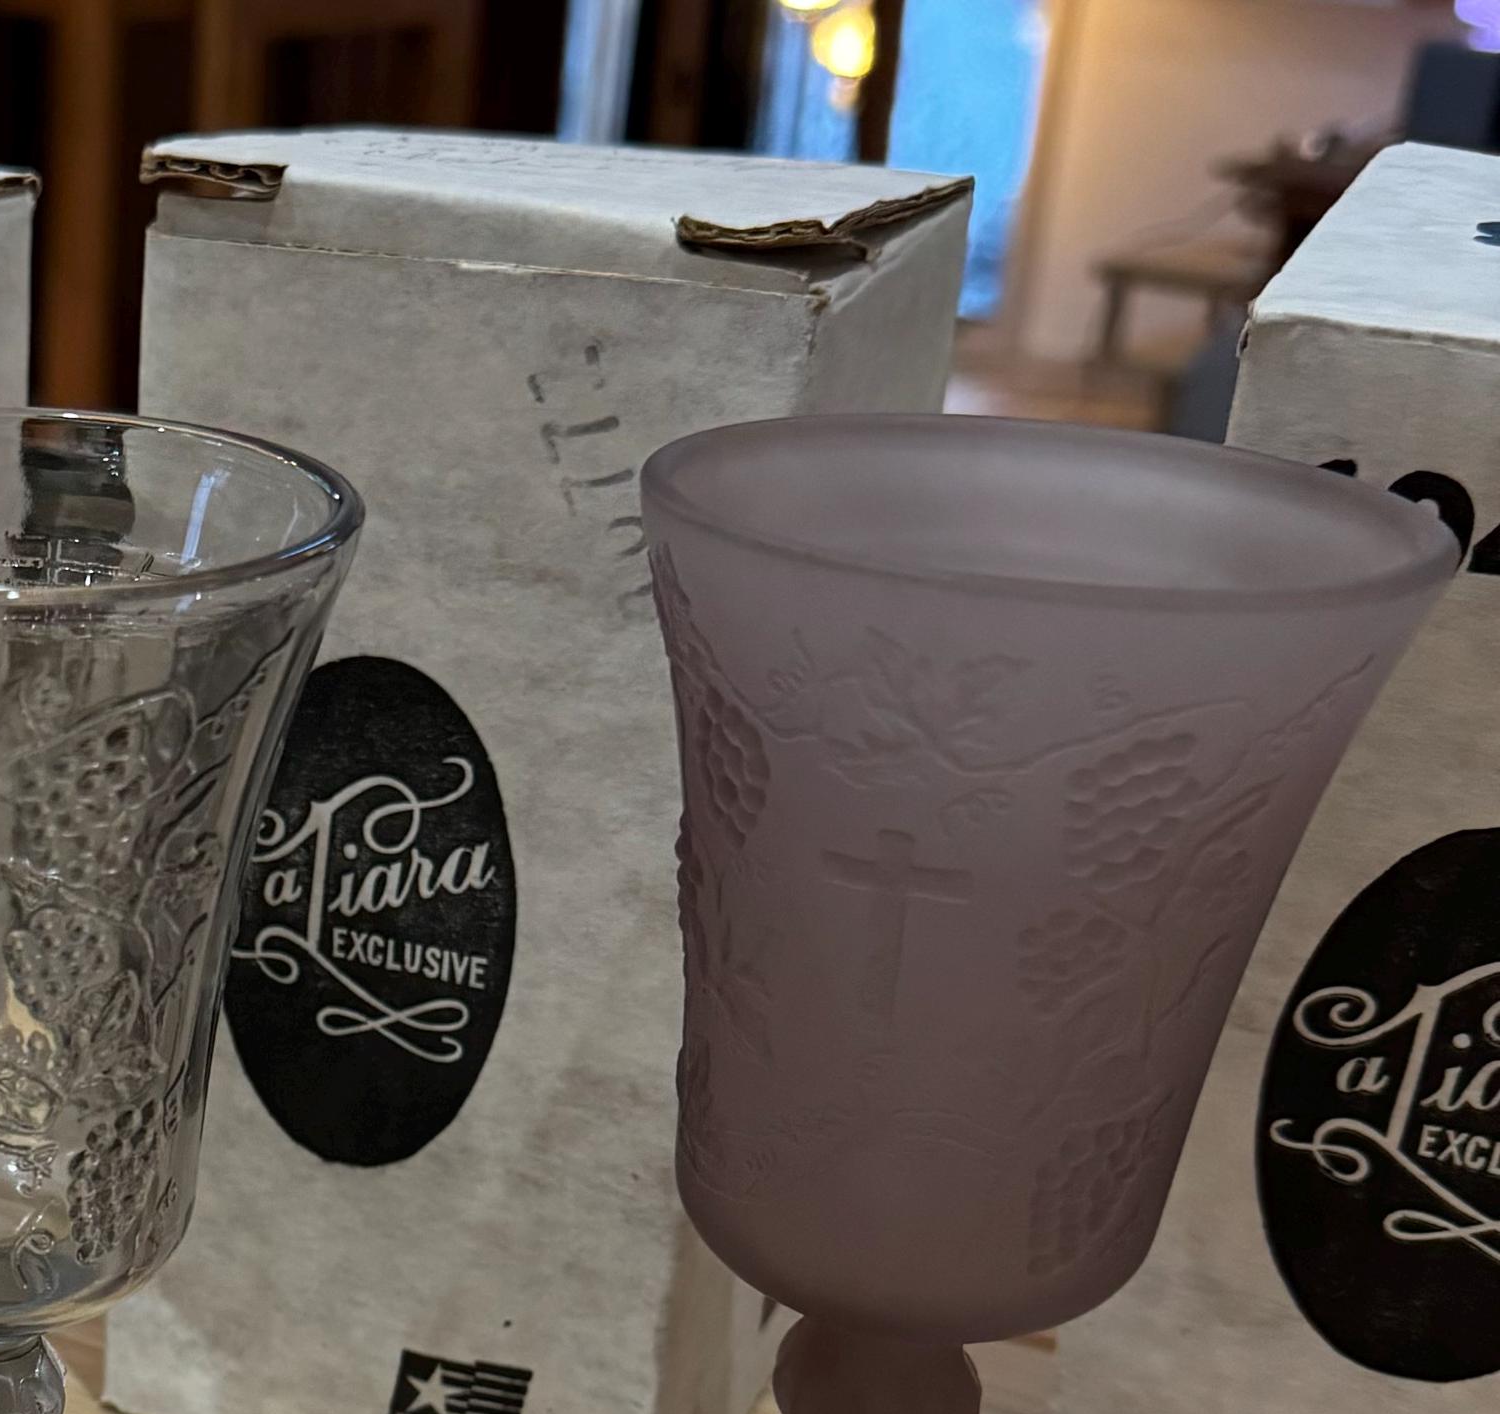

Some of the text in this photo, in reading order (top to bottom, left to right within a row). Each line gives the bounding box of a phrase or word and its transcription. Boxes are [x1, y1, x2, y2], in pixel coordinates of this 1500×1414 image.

[252, 757, 495, 952] a Tiara
[332, 927, 489, 990] EXCLUSIVE
[1336, 1056, 1390, 1093] a
